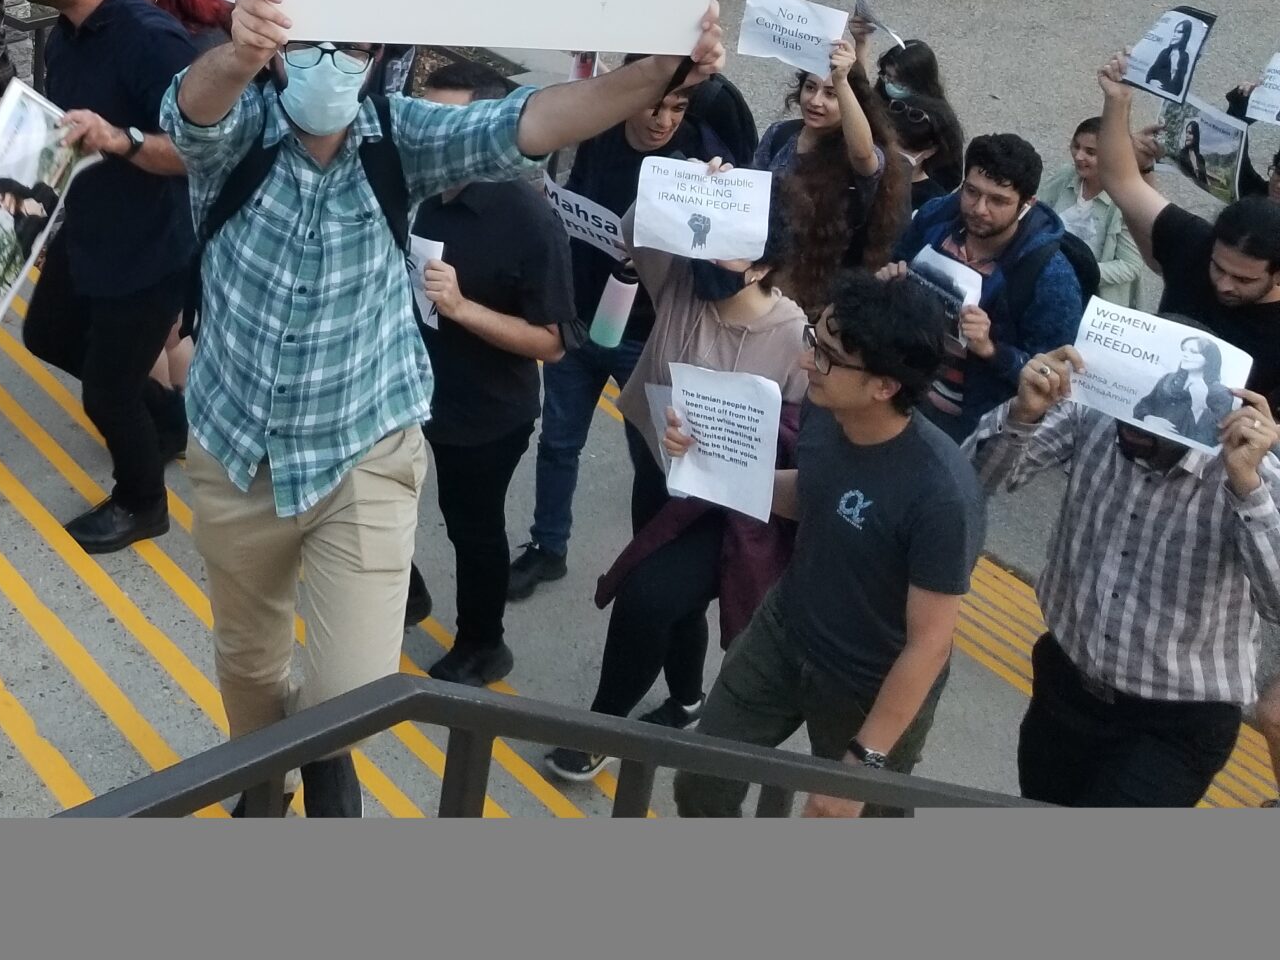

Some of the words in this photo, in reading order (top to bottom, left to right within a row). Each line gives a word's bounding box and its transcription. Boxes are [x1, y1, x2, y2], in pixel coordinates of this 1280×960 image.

[777, 7, 794, 20] No
[797, 14, 808, 25] to
[756, 16, 822, 46] Compulsory
[772, 34, 802, 51] Hijab
[651, 165, 669, 176] The
[674, 169, 708, 183] Islamic
[710, 175, 754, 189] Republic
[676, 182, 687, 191] IS
[690, 184, 732, 198] KILLING
[544, 183, 618, 236] Mahsa
[658, 191, 703, 206] IRANIAN
[706, 200, 751, 213] PEOPLE
[1090, 318, 1125, 337] LIFE!
[1096, 306, 1157, 334] WOMEN!
[1086, 330, 1160, 366] FREEDOM!
[682, 389, 695, 397] The
[696, 392, 721, 404] Iranian
[722, 400, 747, 411] people
[748, 405, 765, 415] have
[685, 400, 703, 409] been
[704, 405, 716, 413] cut
[729, 411, 746, 420] from
[747, 415, 760, 423] the
[716, 417, 735, 427] while
[736, 423, 757, 433] world
[724, 427, 753, 441] meeting
[722, 444, 738, 454] their
[739, 450, 758, 461] voice
